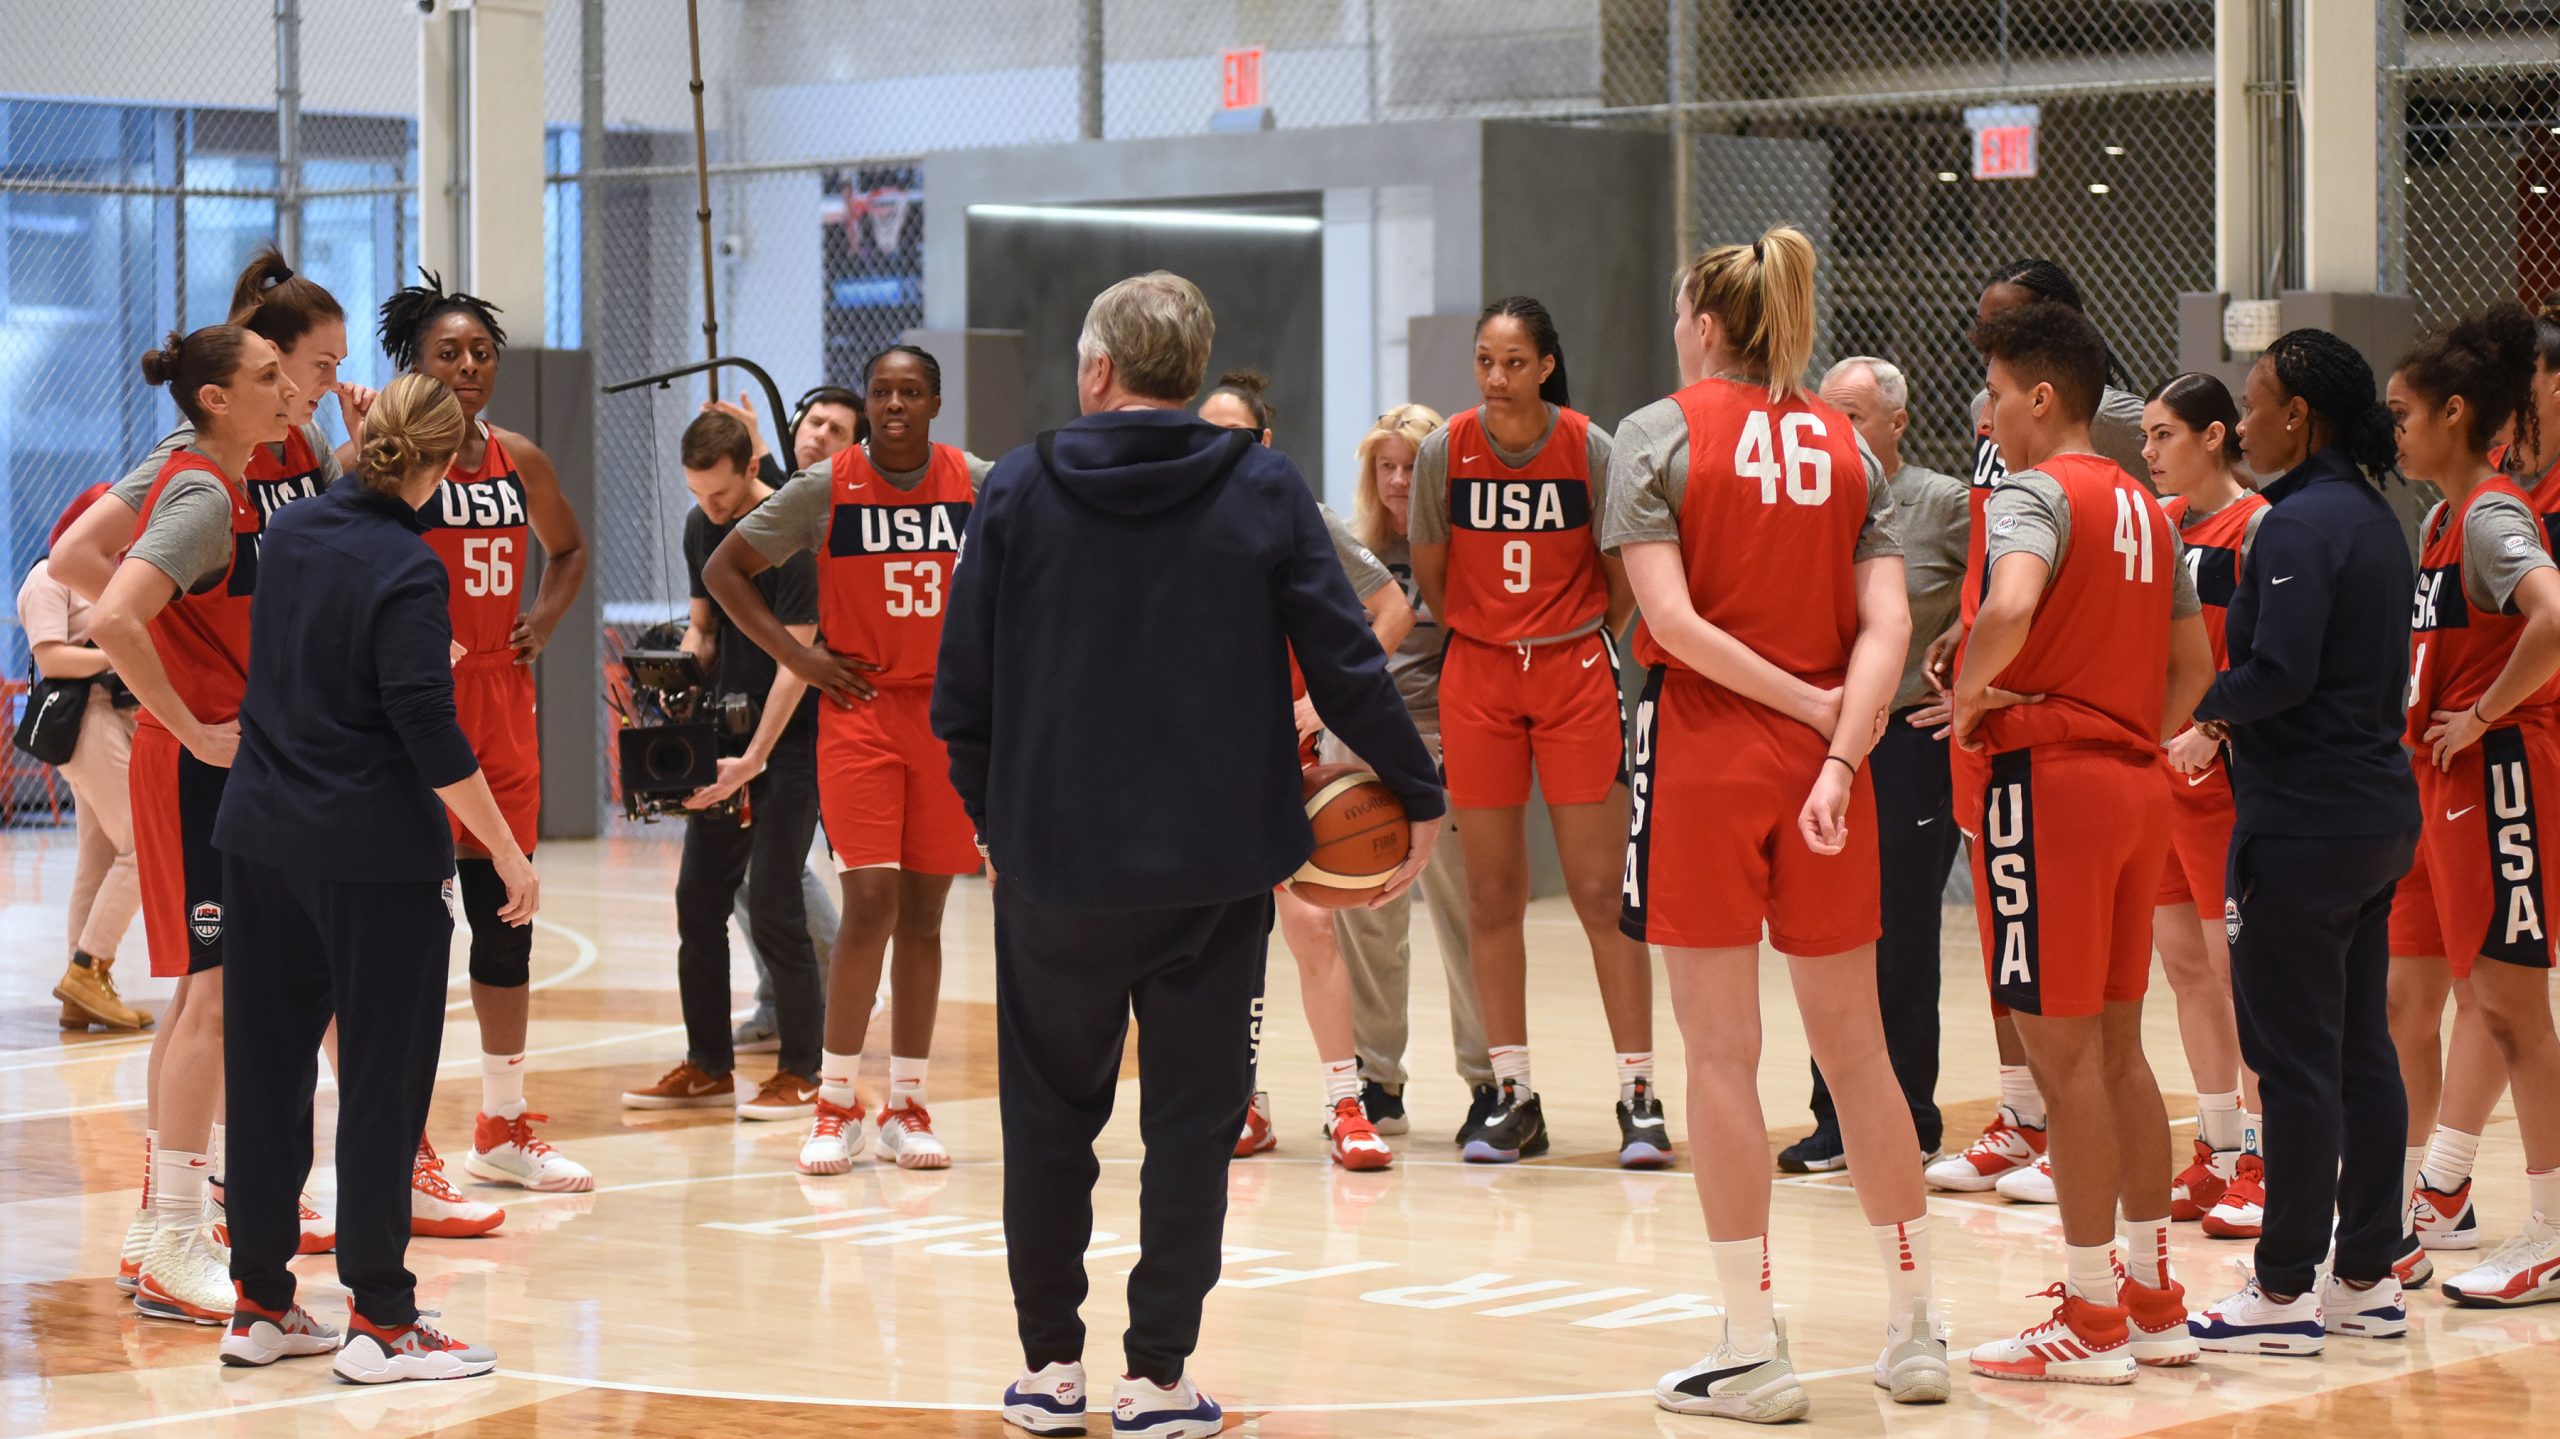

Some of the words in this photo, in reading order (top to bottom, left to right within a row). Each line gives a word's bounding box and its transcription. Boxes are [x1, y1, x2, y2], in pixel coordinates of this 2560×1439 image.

[1223, 50, 1261, 109] EXIT
[1981, 126, 2031, 174] EXIT
[1734, 410, 1832, 506] 46
[442, 479, 525, 526] USA
[861, 504, 958, 553] USA
[1470, 482, 1565, 530] USA
[2113, 487, 2153, 583] 41
[463, 536, 513, 598] 56
[883, 560, 942, 617] 53
[1503, 540, 1531, 593] 9
[2411, 571, 2443, 629] SA
[1622, 700, 1654, 908] USA
[1373, 832, 1397, 852] FIBA
[2491, 761, 2544, 945] USA
[1988, 783, 2032, 986] USA
